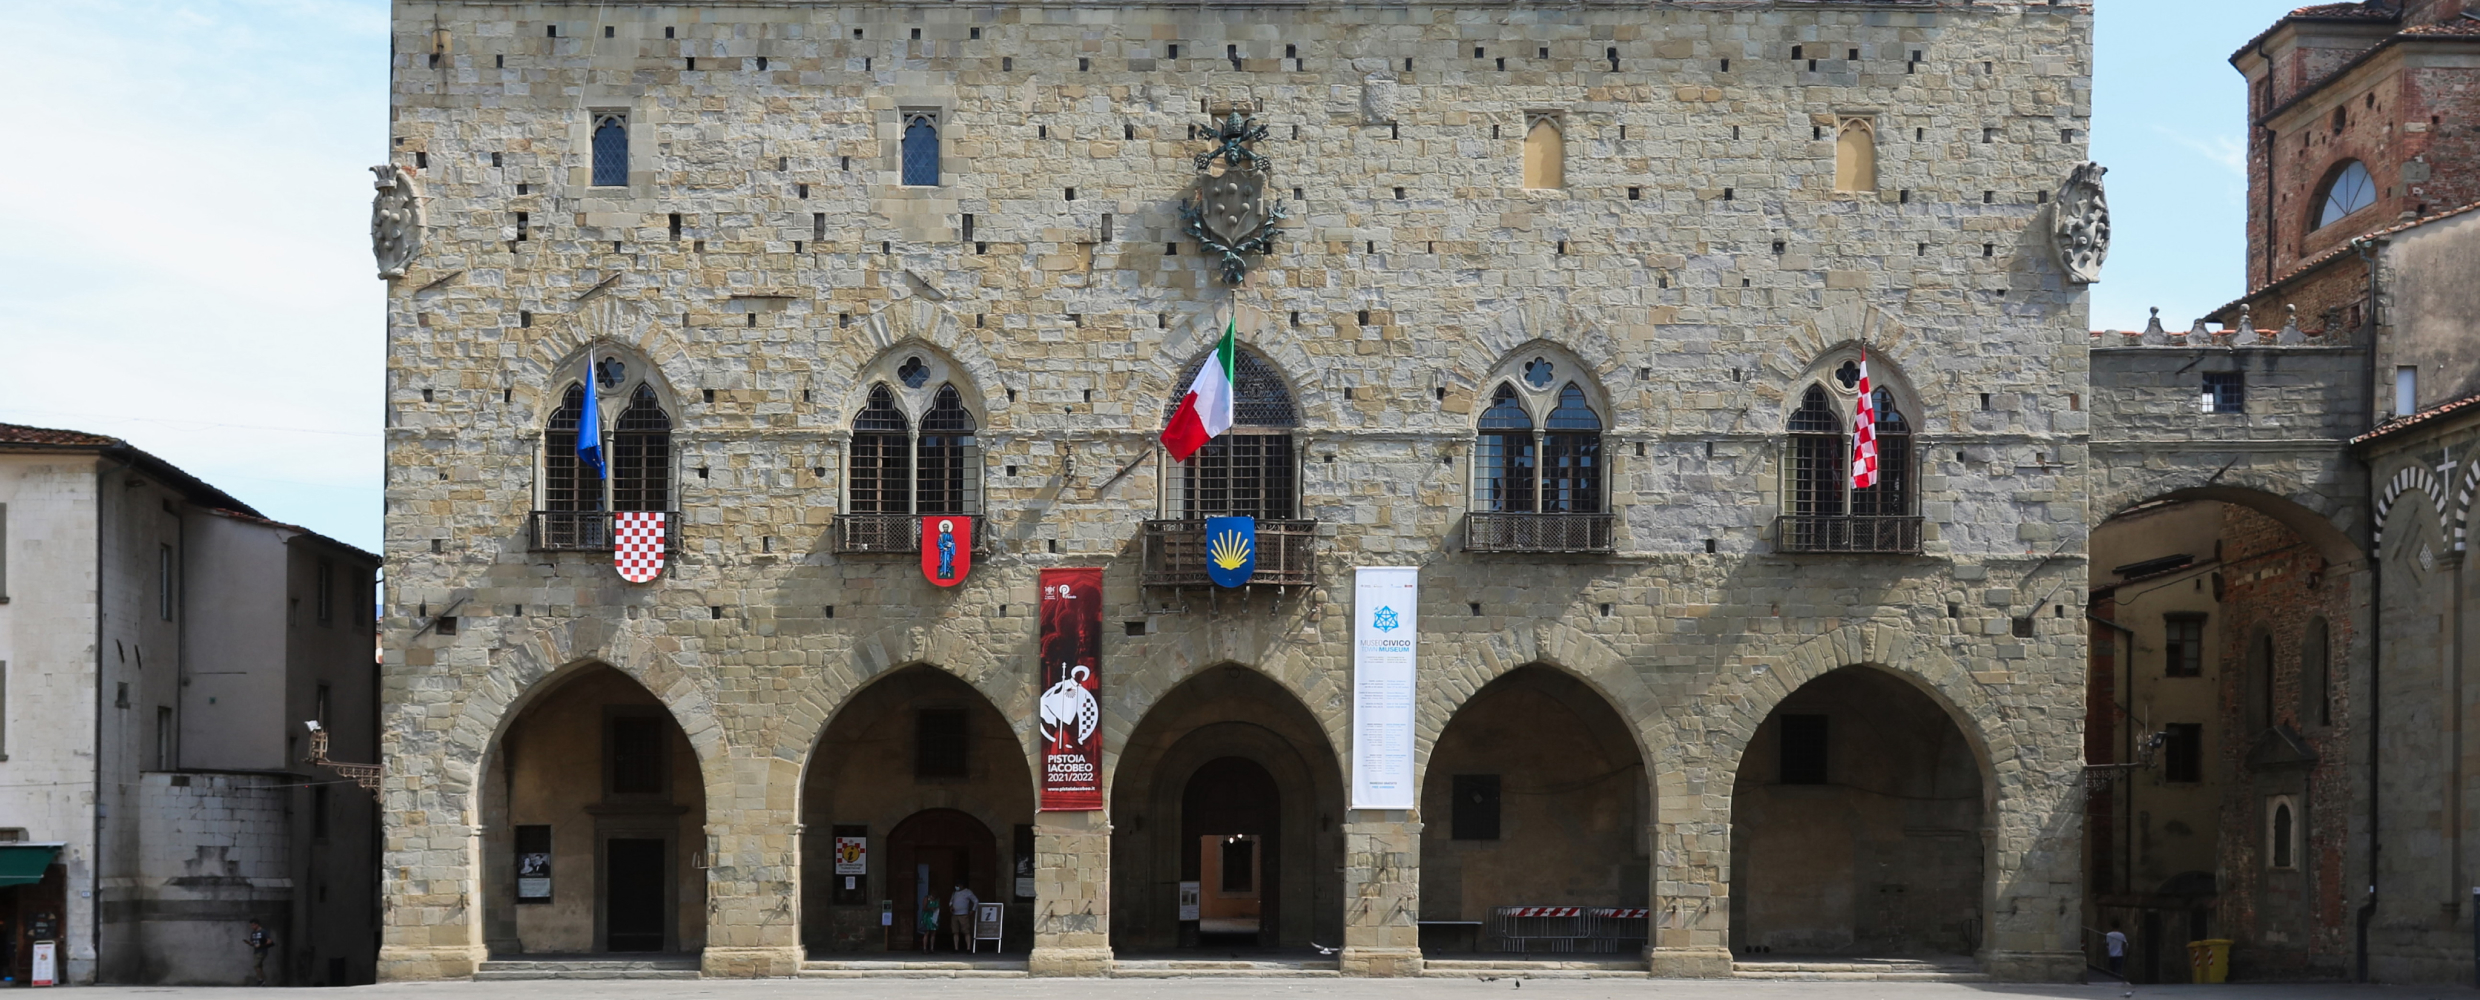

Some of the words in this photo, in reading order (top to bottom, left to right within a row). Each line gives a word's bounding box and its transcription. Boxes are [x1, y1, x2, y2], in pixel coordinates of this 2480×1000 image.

[1048, 754, 1086, 763] PISTOIA
[1048, 763, 1093, 772] IACOBEO
[1048, 773, 1093, 782] 2021/2022
